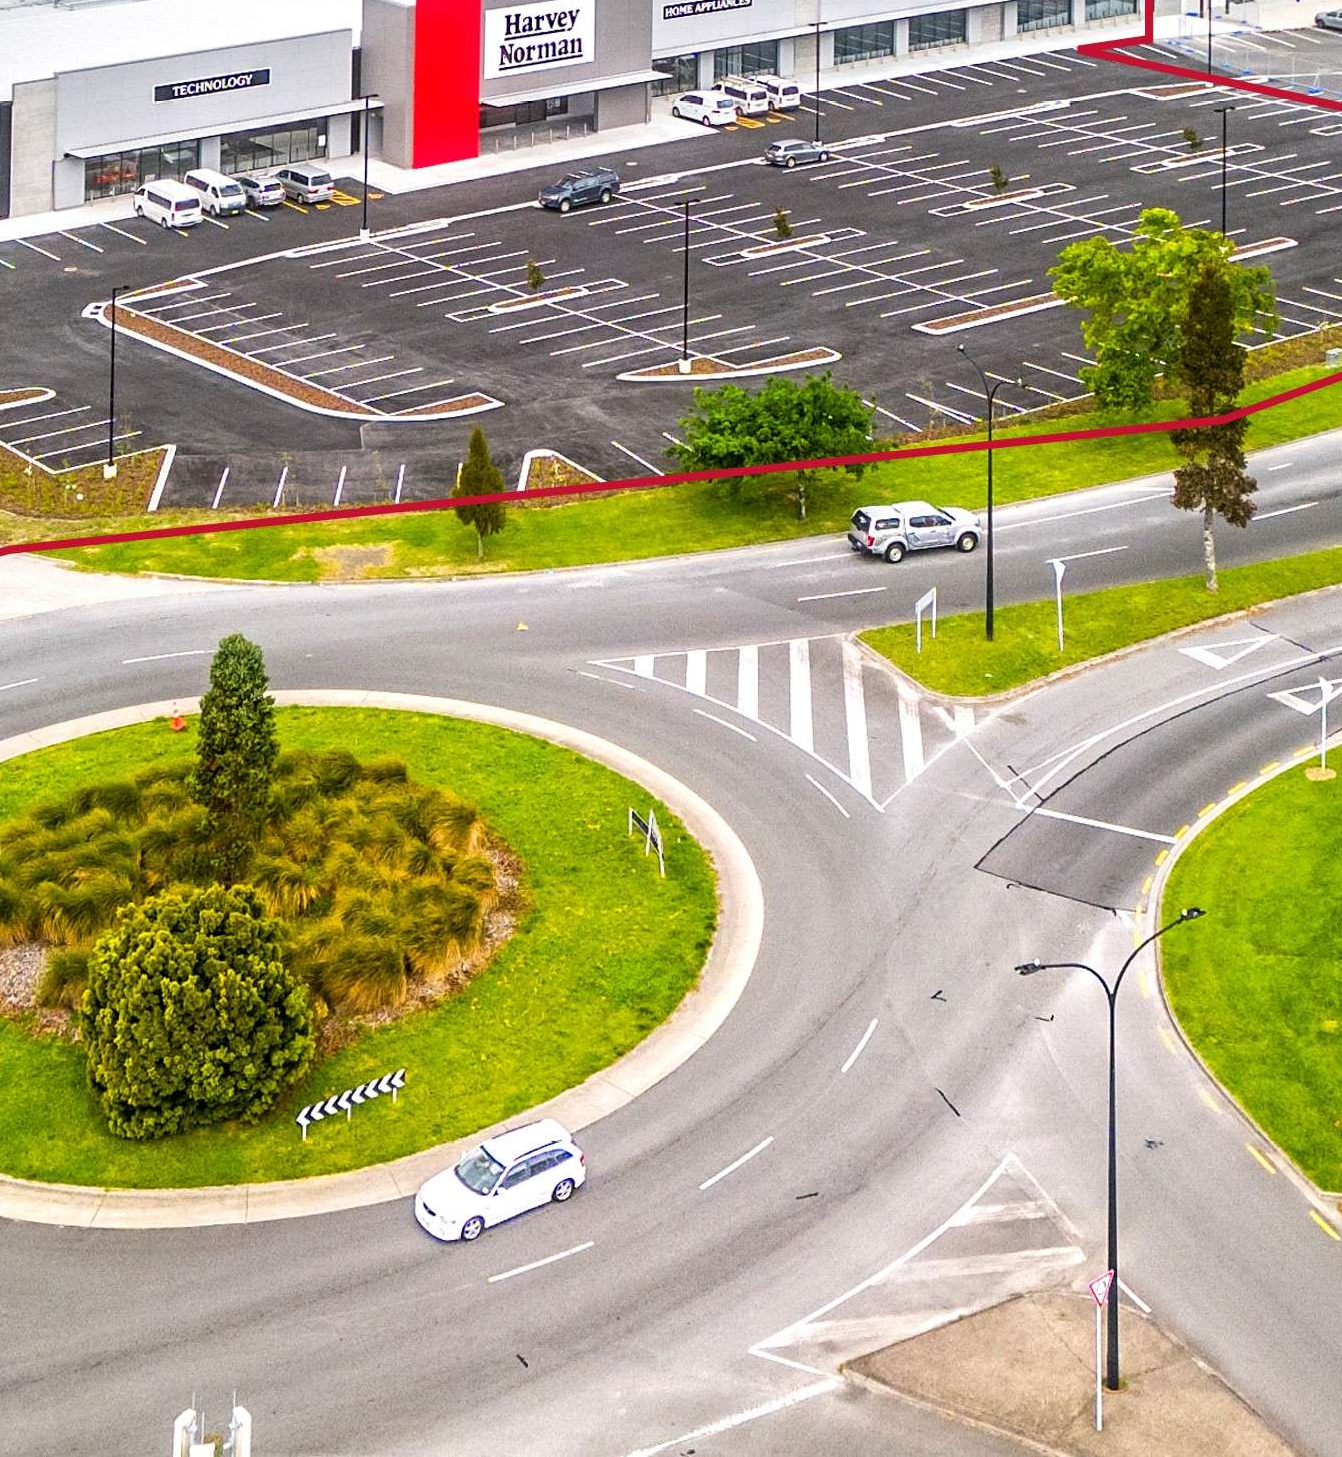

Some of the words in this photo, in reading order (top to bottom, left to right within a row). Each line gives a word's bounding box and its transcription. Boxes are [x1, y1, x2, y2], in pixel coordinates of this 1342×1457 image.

[504, 8, 581, 36] Harvey
[664, 5, 694, 18] HOME
[498, 37, 583, 66] Norman
[172, 74, 253, 97] TECHNOLOGY
